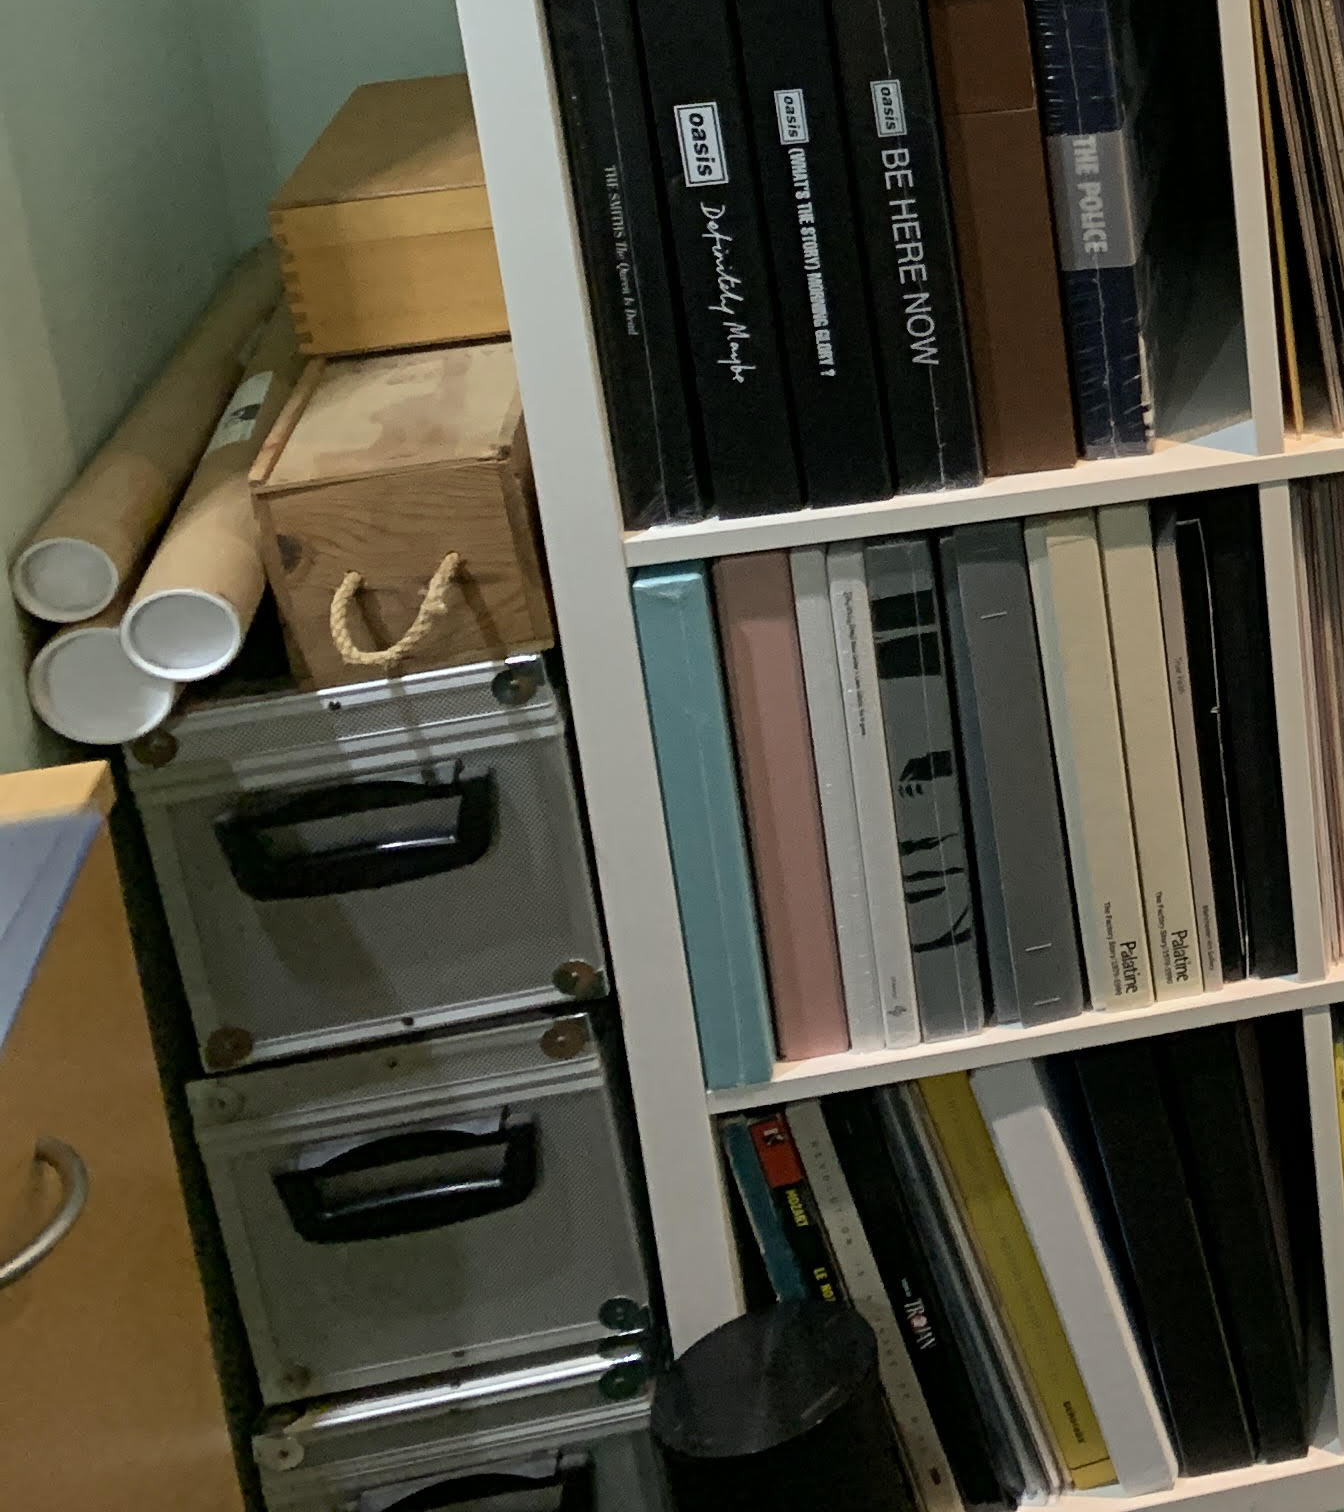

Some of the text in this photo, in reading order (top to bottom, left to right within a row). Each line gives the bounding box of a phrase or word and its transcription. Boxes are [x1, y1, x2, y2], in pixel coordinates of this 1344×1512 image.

[781, 93, 802, 139] oasis
[879, 85, 899, 130] oasis
[688, 110, 714, 178] oasis
[602, 164, 619, 191] THE
[787, 146, 811, 200] (WHAT'S
[1071, 134, 1108, 253] THE POLICE
[606, 191, 627, 240] SMITHS
[795, 201, 815, 225] THE
[614, 240, 629, 260] The
[798, 225, 821, 271] STORY)
[879, 146, 940, 369] BE HERE NOW
[615, 261, 634, 296] Queen
[694, 197, 757, 386] Definitely Maybe
[806, 271, 829, 328] MORNING
[623, 307, 640, 338] Dead
[813, 327, 834, 366] GLORY
[1118, 939, 1142, 994] Palatine
[1171, 928, 1194, 983] Palatine
[783, 1186, 809, 1230] MOZART
[811, 1264, 829, 1282] LE
[901, 1297, 939, 1352] TROJAN
